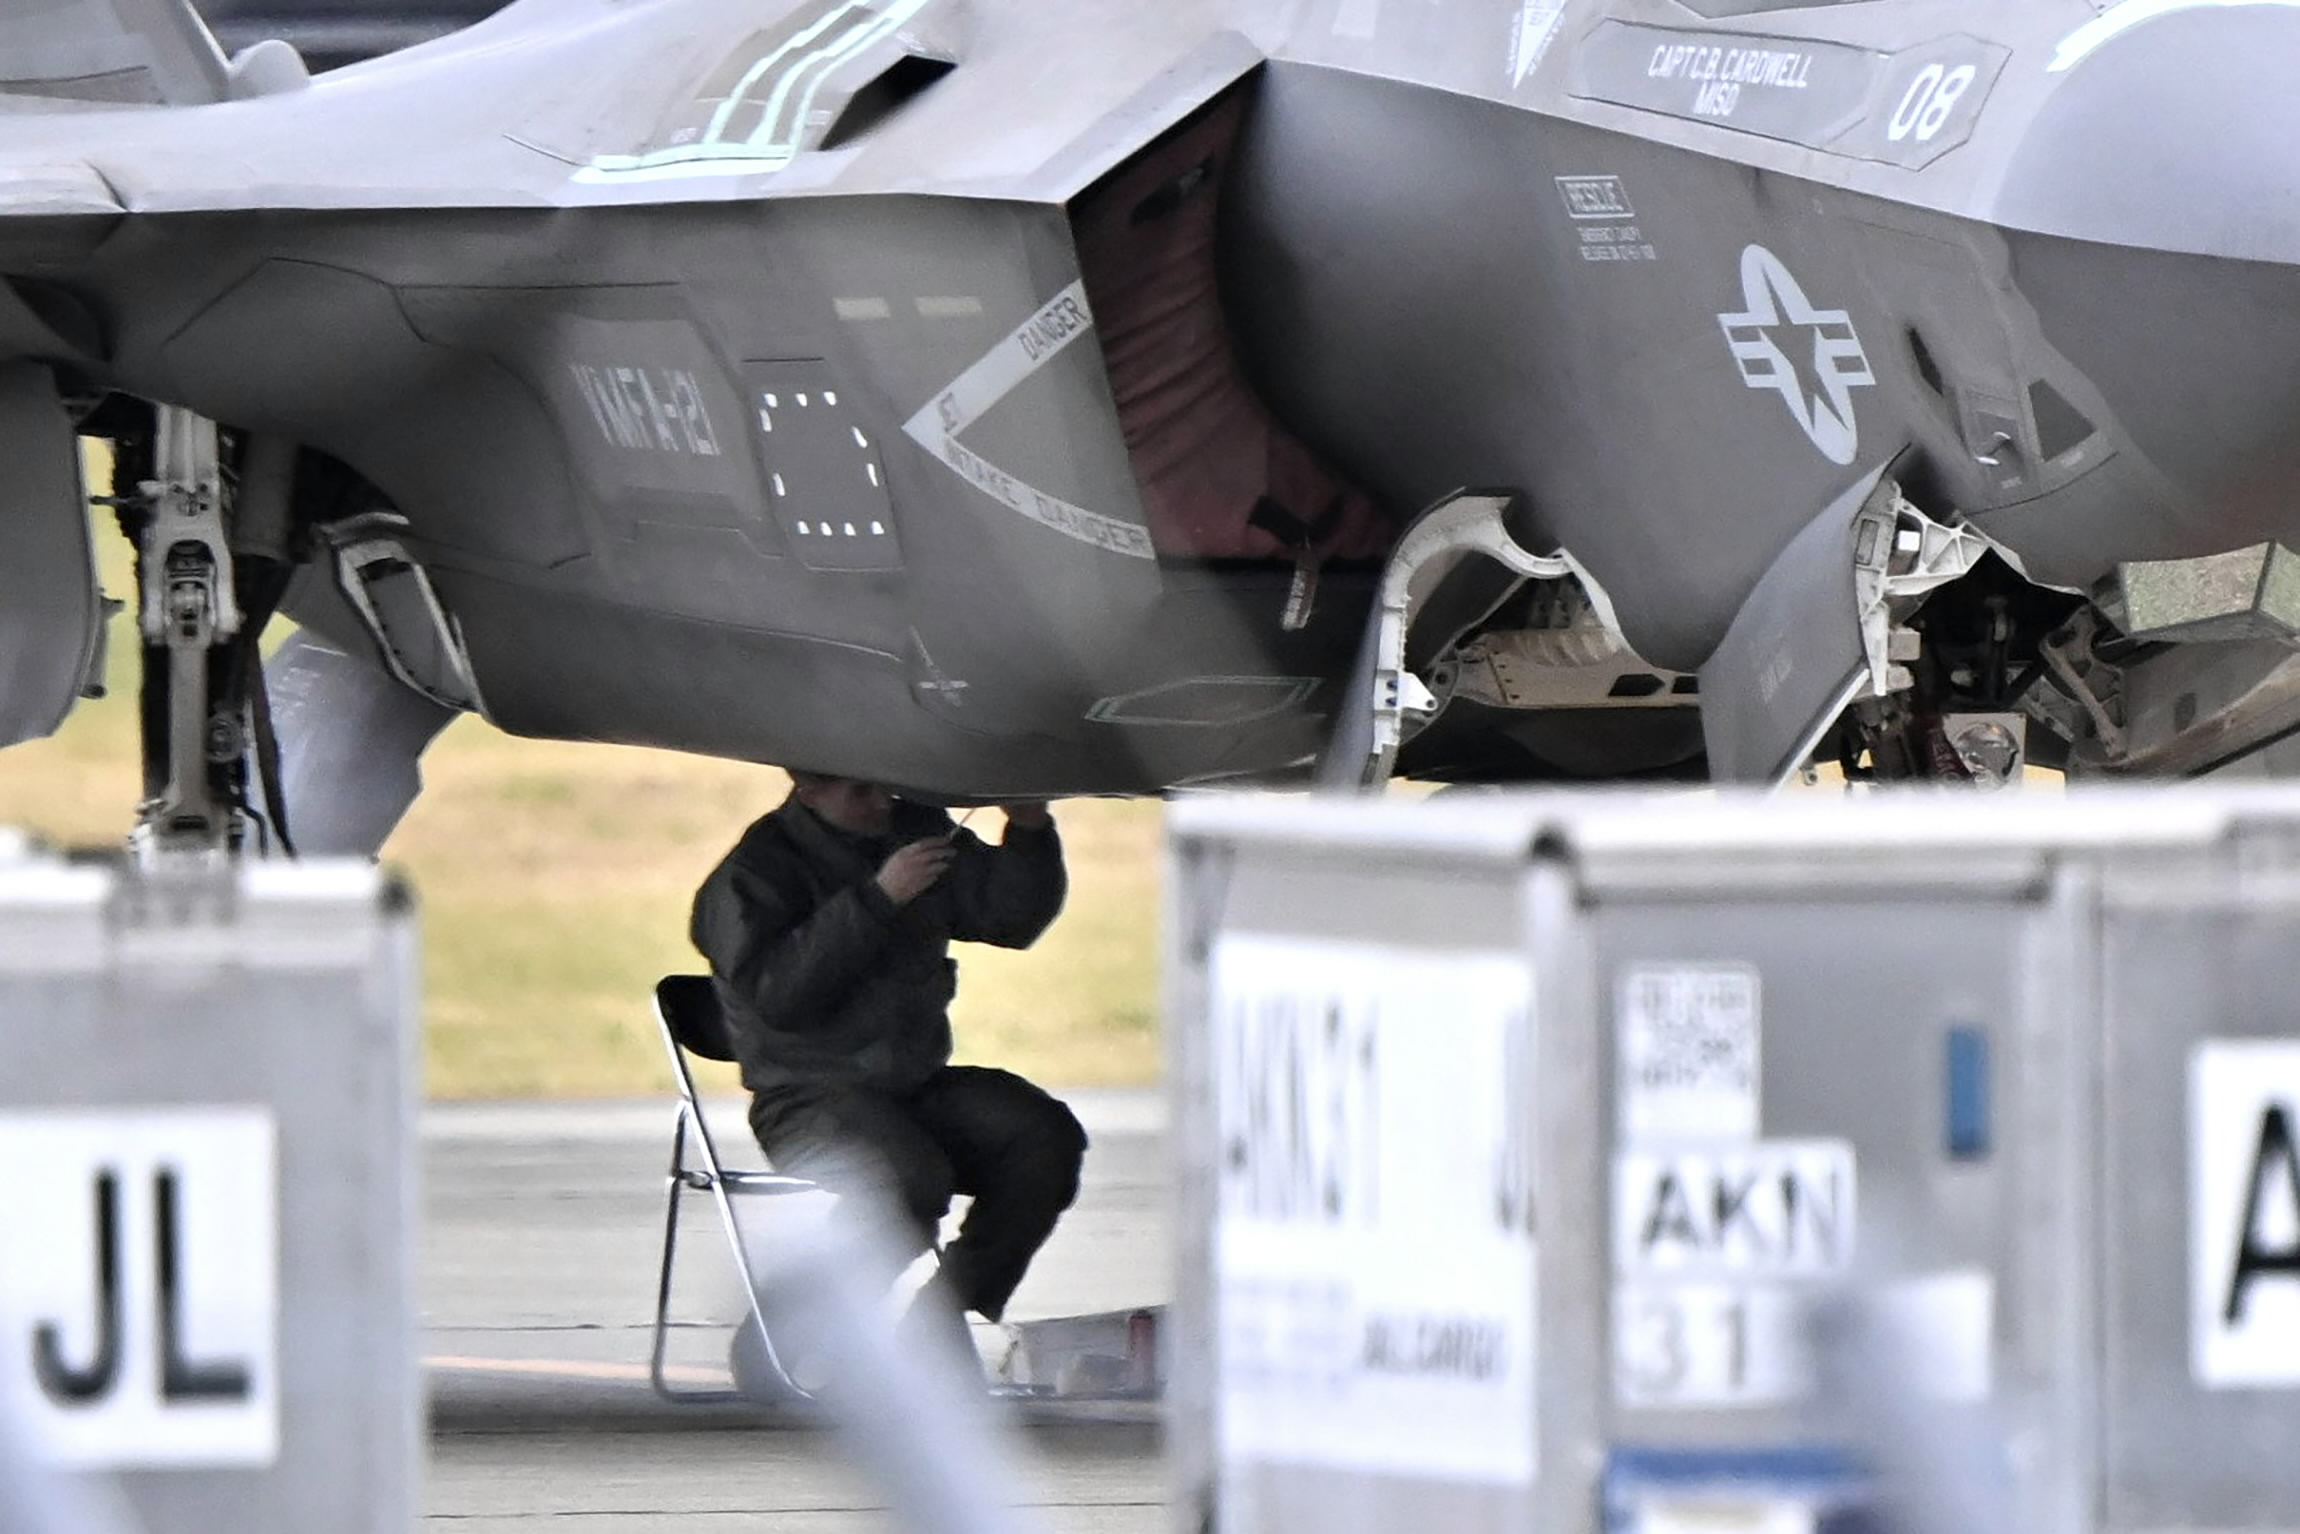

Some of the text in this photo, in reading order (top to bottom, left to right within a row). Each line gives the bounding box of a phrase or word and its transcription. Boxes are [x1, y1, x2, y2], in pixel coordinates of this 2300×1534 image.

[1719, 49, 1812, 88] CARDWELL
[1888, 64, 1976, 141] 08
[1017, 296, 1088, 362] DANGER
[1638, 1171, 1840, 1264] AKN
[31, 1163, 253, 1410] JL
